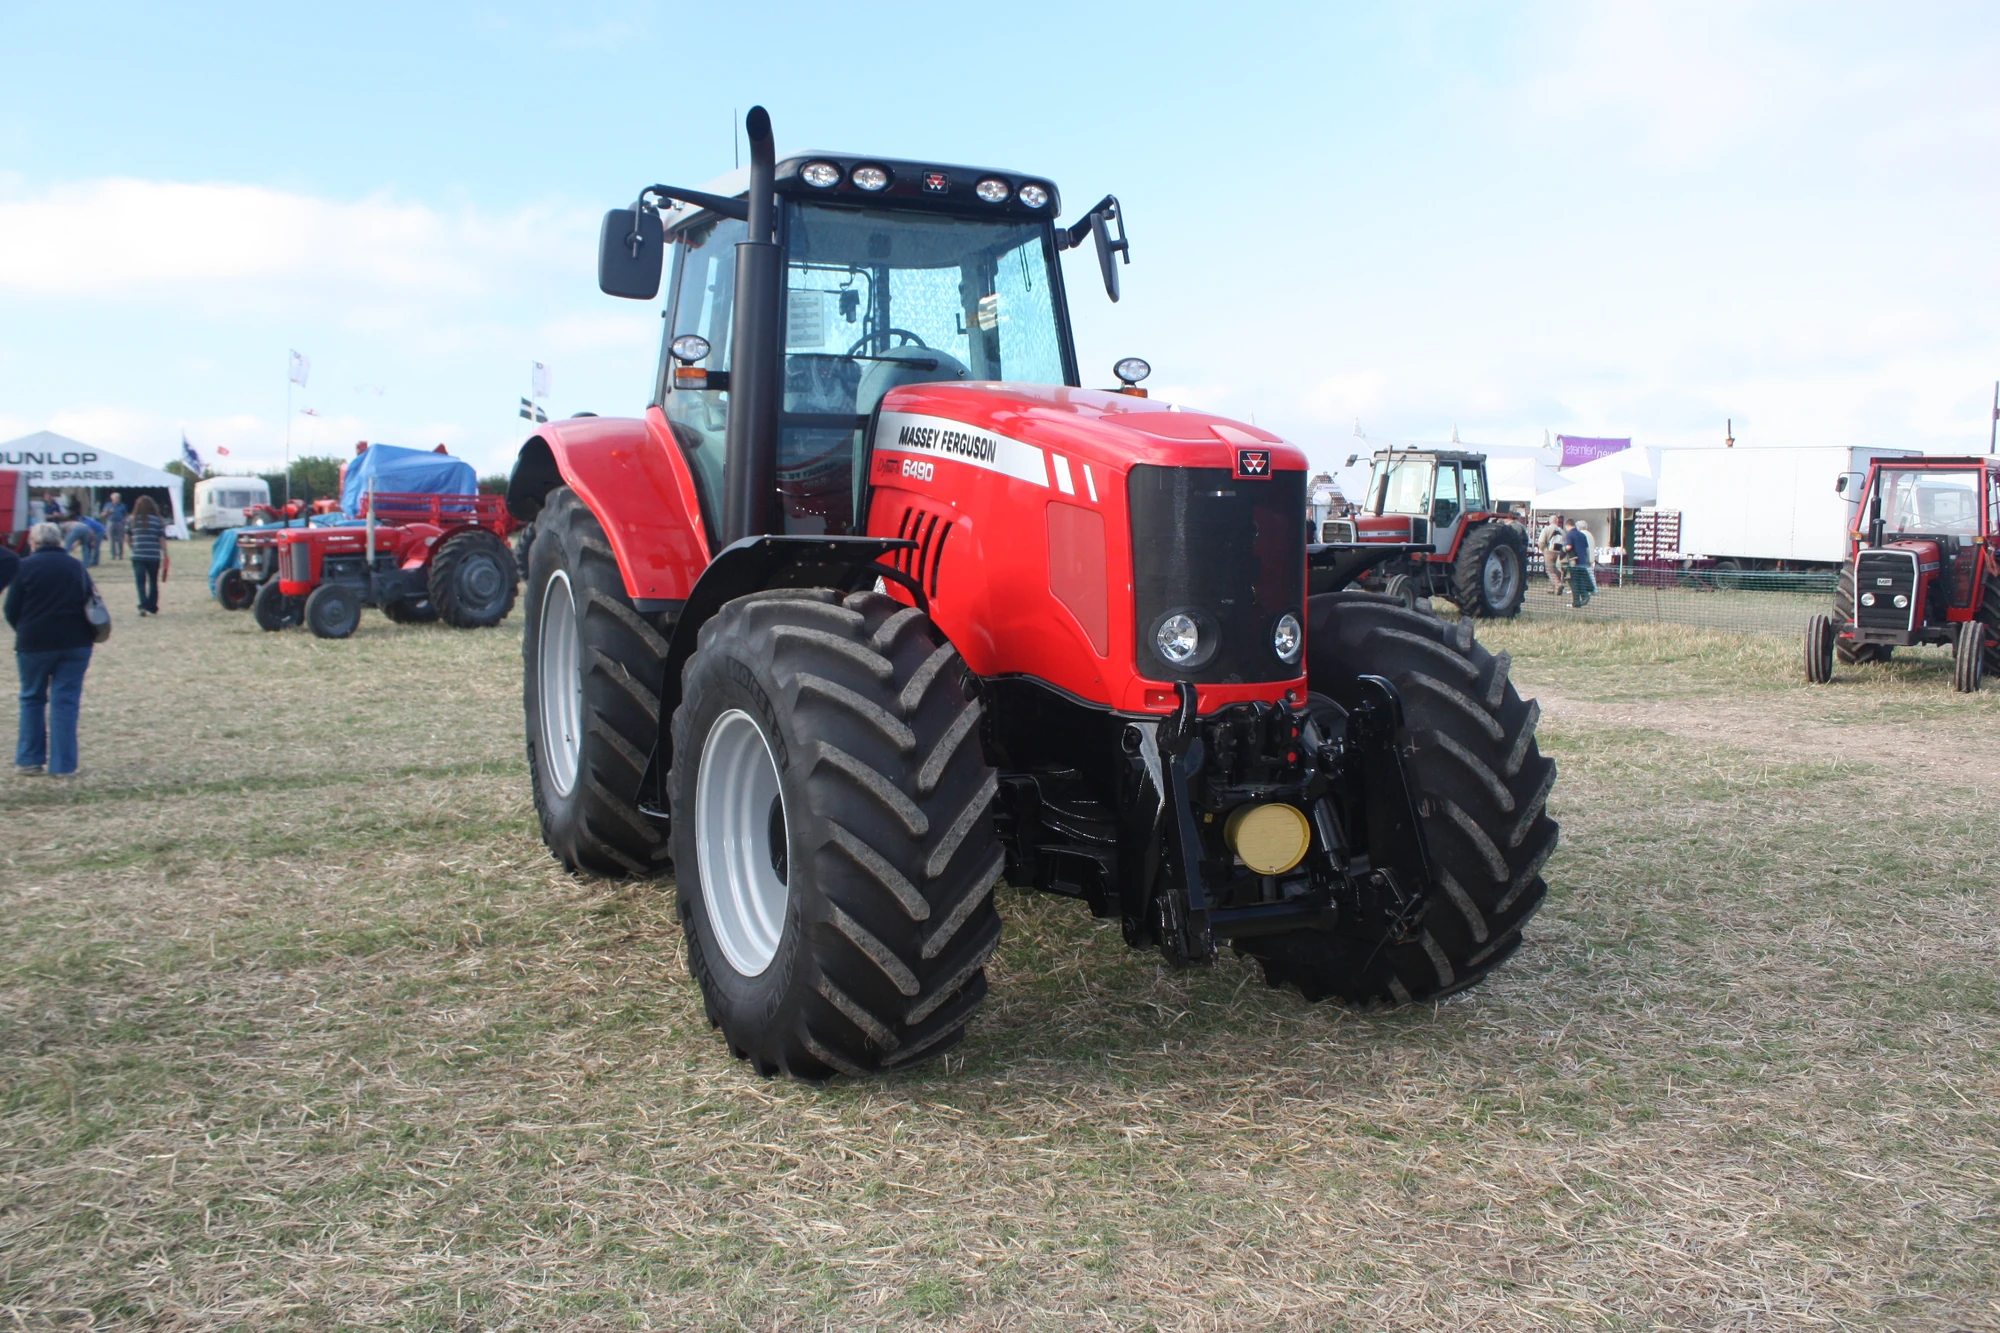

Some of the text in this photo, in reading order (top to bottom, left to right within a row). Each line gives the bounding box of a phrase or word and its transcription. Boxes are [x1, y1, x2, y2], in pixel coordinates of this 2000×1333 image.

[898, 425, 997, 464] MASSEY FERGUSON
[0, 452, 98, 465] UNLOP
[51, 470, 114, 480] SPARES
[902, 458, 935, 482] 6490
